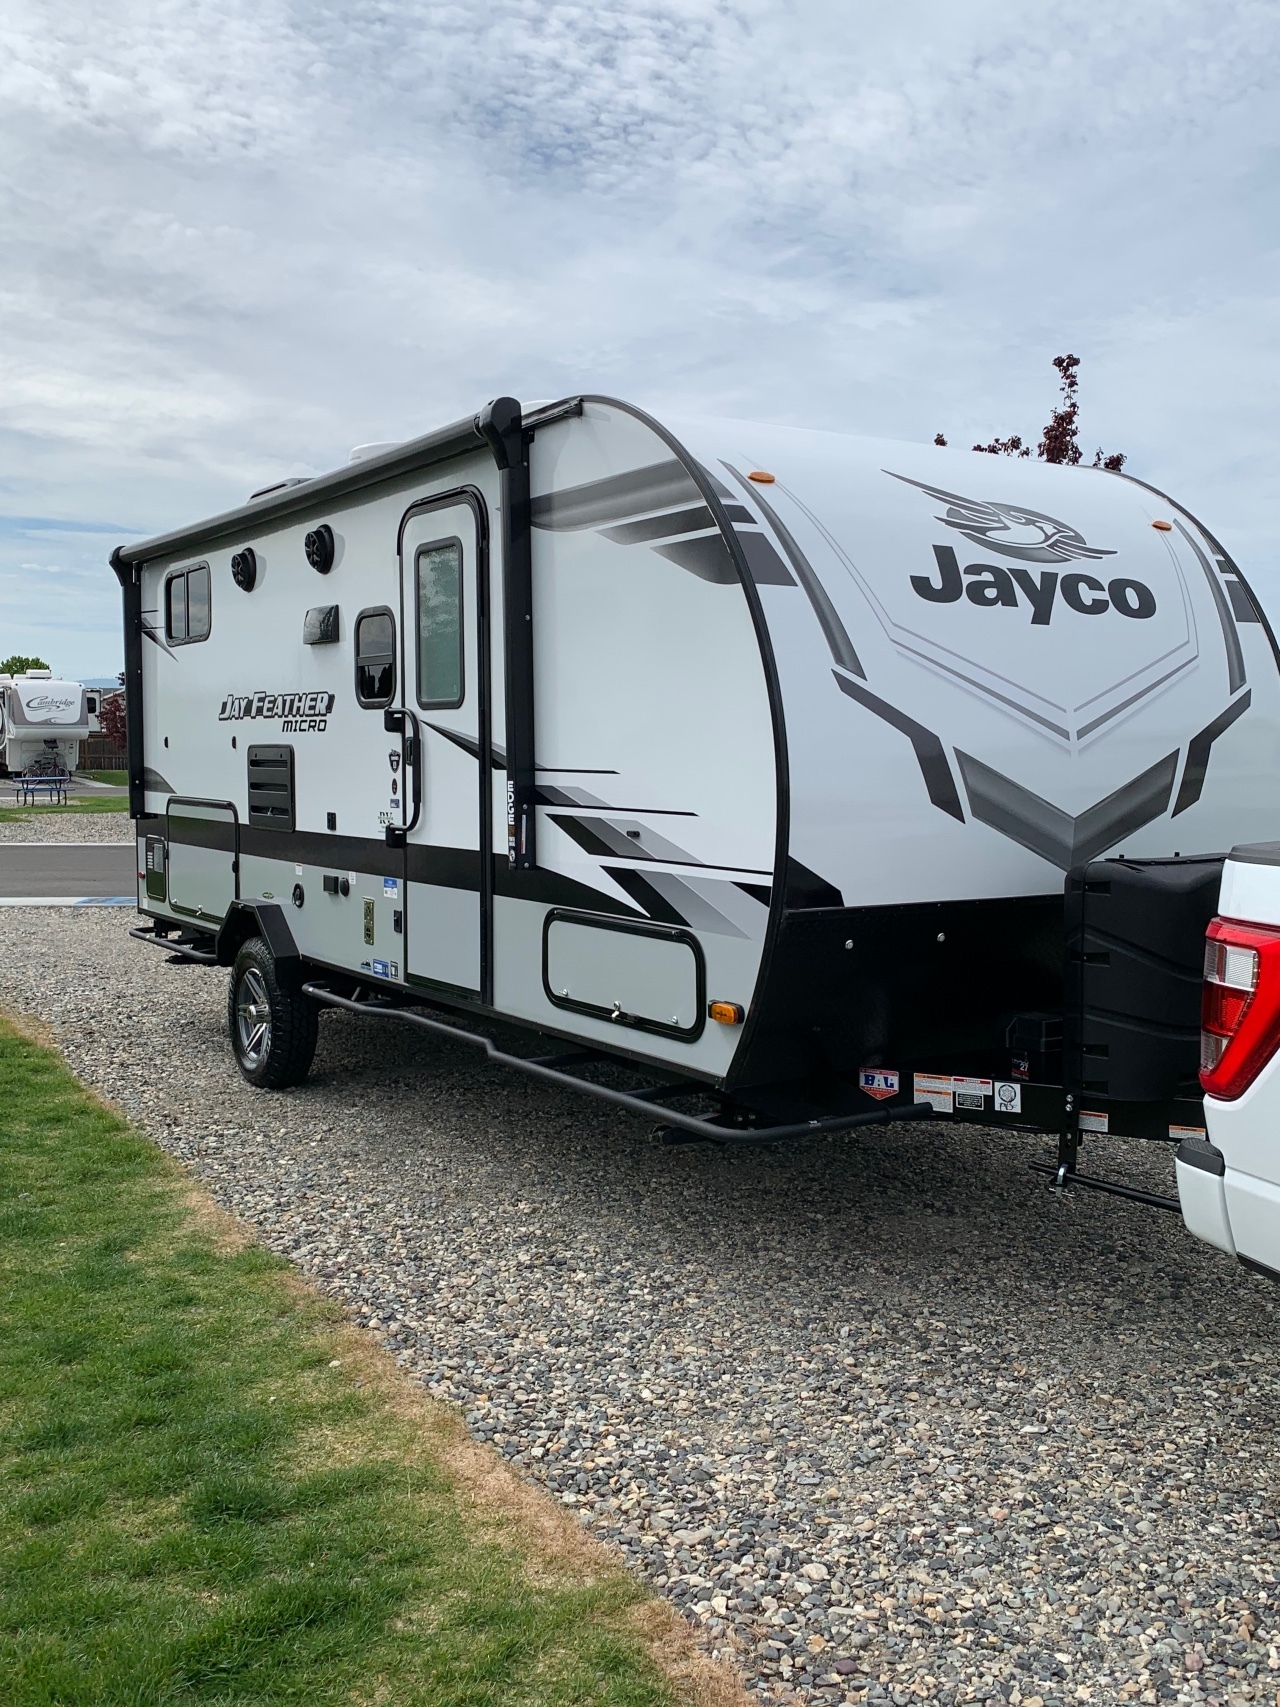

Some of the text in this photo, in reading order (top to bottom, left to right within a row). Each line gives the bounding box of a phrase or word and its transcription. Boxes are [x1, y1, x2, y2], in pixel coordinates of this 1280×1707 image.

[909, 544, 1157, 626] Jayco
[26, 695, 75, 712] Cambridge
[219, 691, 335, 721] JAY FEATHER
[282, 720, 327, 732] MICRO
[507, 780, 516, 826] EDGE
